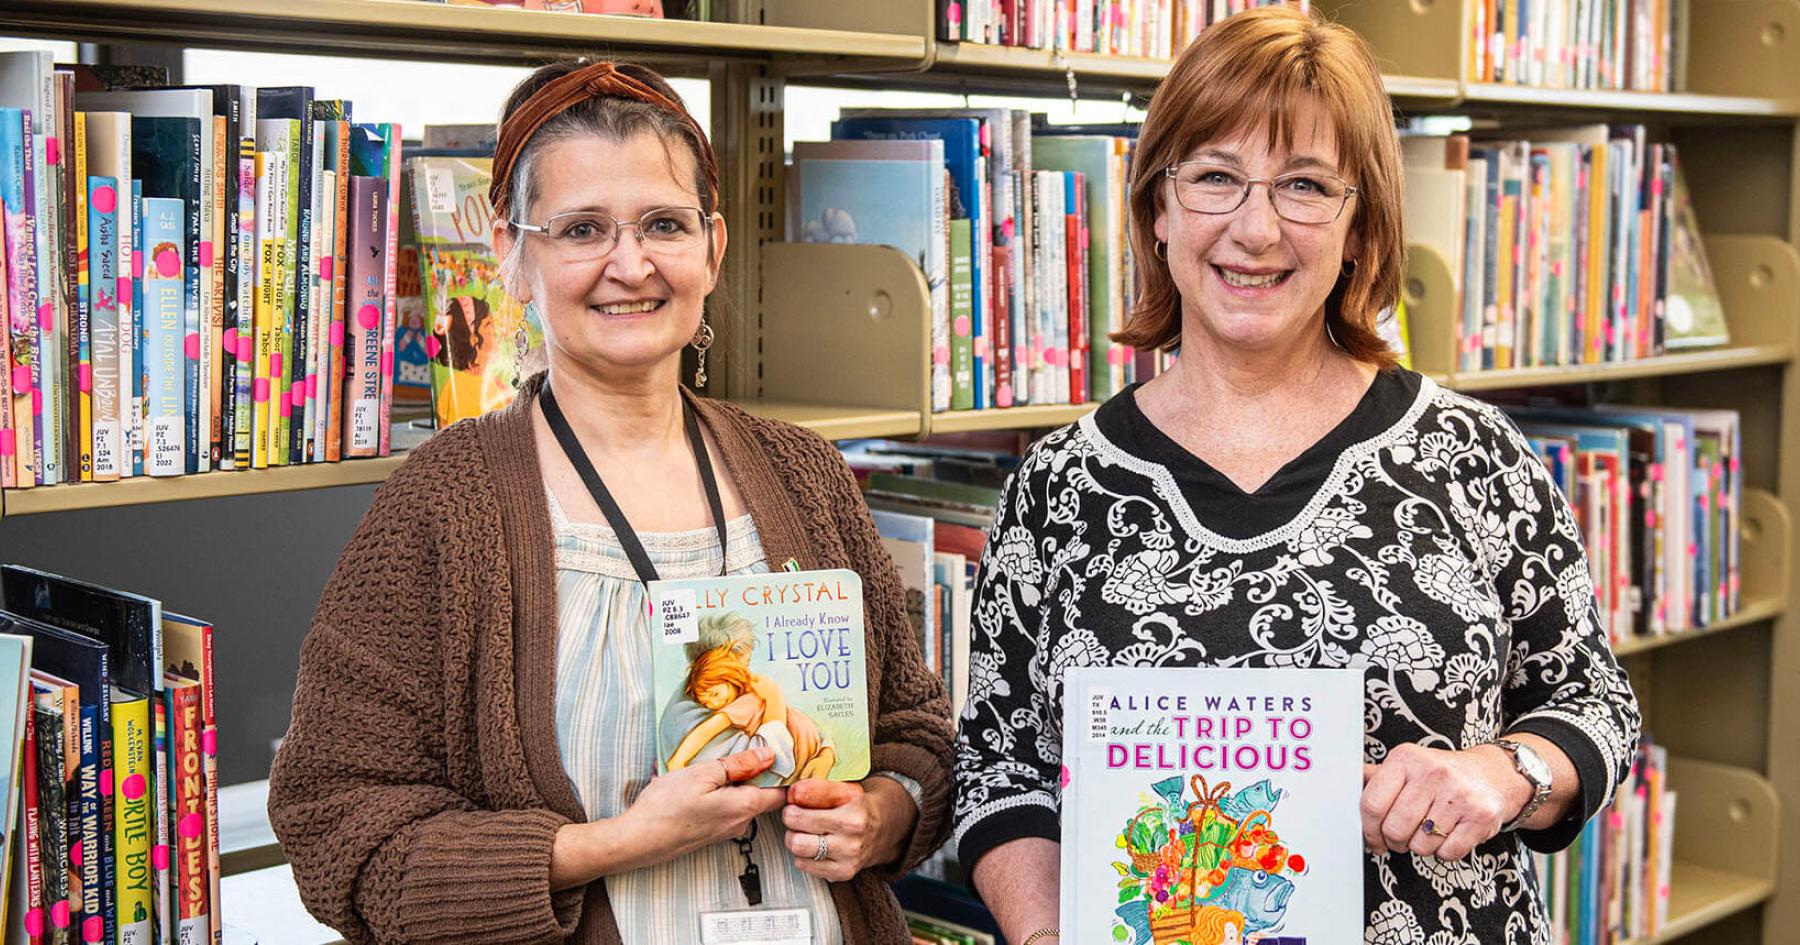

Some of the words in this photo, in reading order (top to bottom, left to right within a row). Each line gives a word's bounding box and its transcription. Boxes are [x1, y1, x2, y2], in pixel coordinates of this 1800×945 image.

[244, 165, 253, 195] Snider
[26, 214, 36, 260] ¡Vamos!
[100, 218, 112, 245] Aisha
[68, 243, 77, 268] JUST
[121, 234, 132, 264] HOT
[28, 262, 37, 288] Let's
[101, 250, 114, 280] Saeed
[193, 267, 199, 275] A
[214, 256, 224, 276] THE
[228, 258, 237, 274] City
[243, 258, 252, 276] boy
[70, 274, 78, 298] LIKE
[300, 264, 308, 310] ALMONDS
[336, 275, 344, 305] FLY
[367, 289, 378, 297] the
[28, 291, 38, 324] Cross
[160, 288, 177, 329] ELLEN
[241, 282, 251, 330] watching
[30, 326, 38, 344] the
[70, 302, 79, 356] GRANDMA
[80, 302, 88, 342] STRONG
[94, 319, 117, 365] AMAL
[120, 322, 132, 354] DOG
[274, 326, 283, 353] Tabor
[30, 344, 40, 383] Bridge
[163, 335, 175, 372] OUTSIDE
[164, 376, 174, 392] THE
[365, 372, 378, 399] STRE
[742, 580, 848, 606] CRYSTAL
[766, 616, 770, 628] I
[774, 614, 816, 629] Already
[819, 612, 849, 625] Know
[767, 633, 776, 661] I
[785, 628, 851, 660] LOVE
[798, 660, 850, 692] YOU
[817, 703, 854, 711] ELIZABETH
[1110, 696, 1187, 711] ALICE
[1205, 696, 1312, 712] WATERS
[82, 717, 92, 755] WILLINK
[1110, 720, 1142, 736] and
[1146, 717, 1171, 736] the
[1172, 716, 1252, 740] TRIP
[1265, 716, 1312, 740] TO
[102, 740, 112, 767] RED
[127, 720, 135, 774] WOLKENSTEIN
[1107, 744, 1312, 771] DELICIOUS
[82, 764, 96, 798] WAY
[208, 769, 219, 815] MAMA'S
[70, 801, 78, 814] The
[104, 796, 112, 831] REEN
[28, 808, 38, 839] PLAYING
[69, 817, 80, 836] Talk
[209, 818, 219, 851] HOME
[30, 842, 38, 862] WITH
[58, 818, 68, 897] WATERCRESS
[82, 815, 98, 886] WARRIOR
[31, 864, 41, 907] LANTERNS
[105, 856, 114, 887] BLUE
[126, 851, 148, 890] BOY
[84, 888, 98, 914] KID
[106, 909, 115, 945] WHITE
